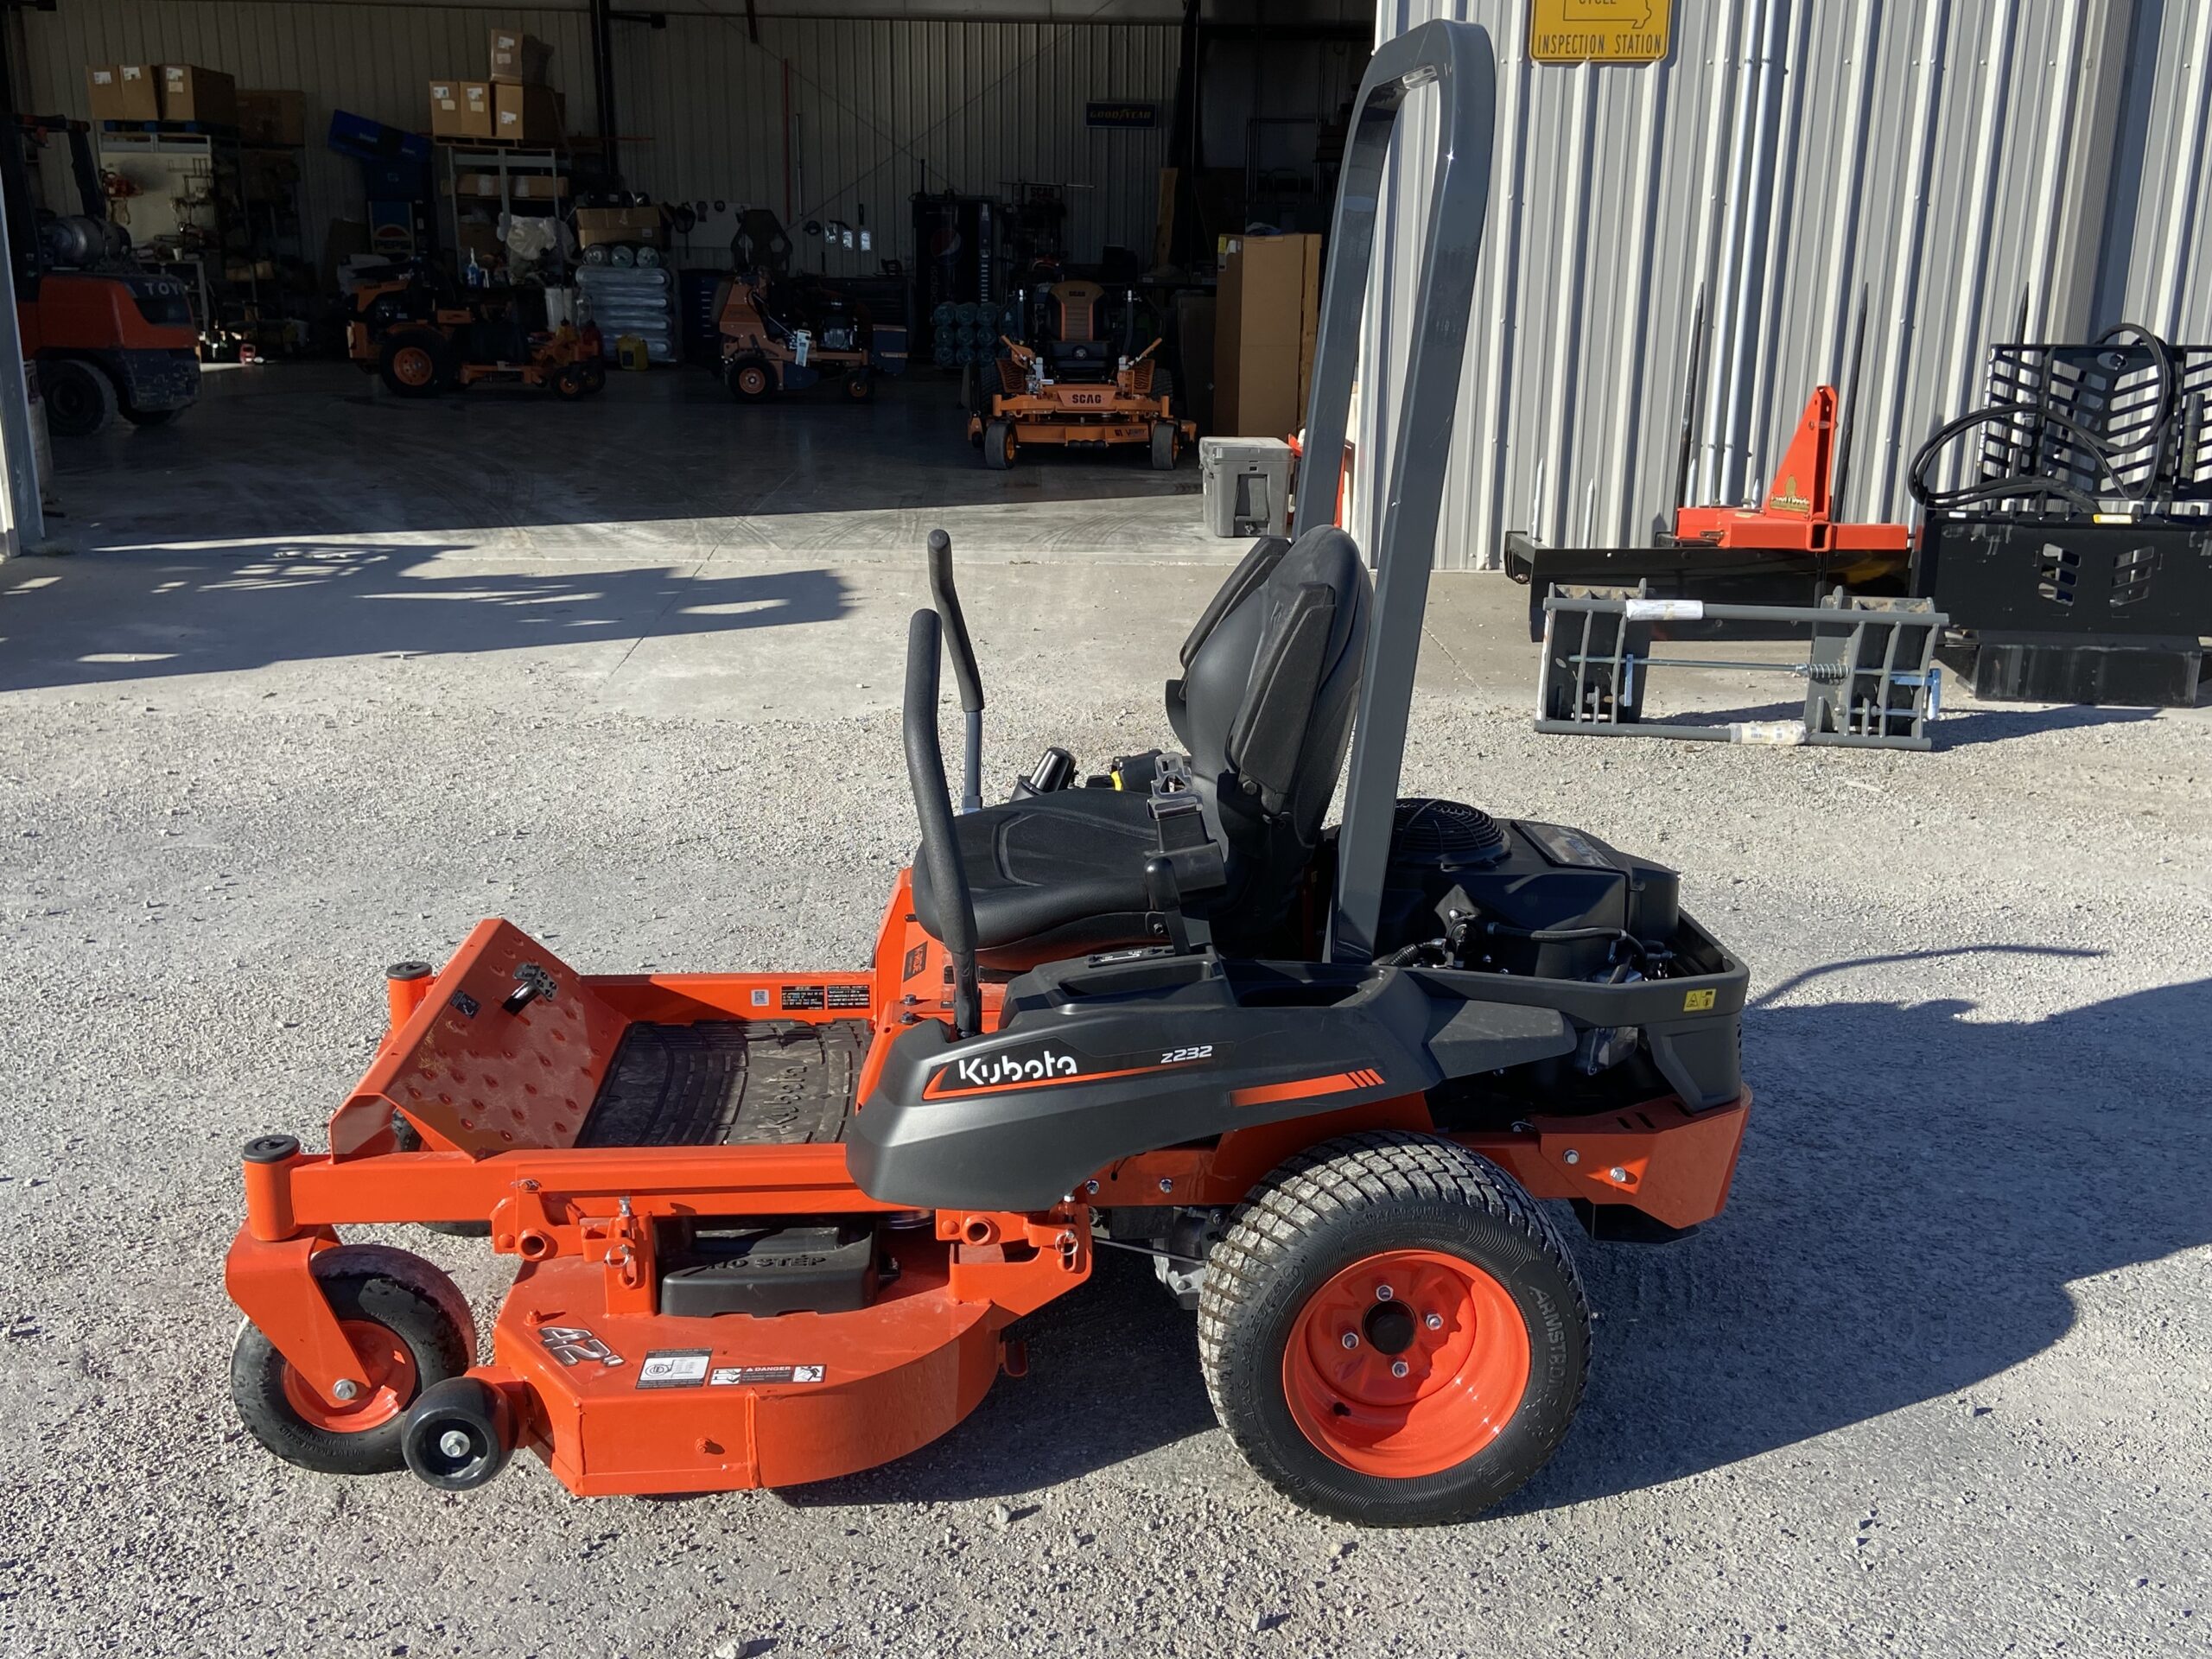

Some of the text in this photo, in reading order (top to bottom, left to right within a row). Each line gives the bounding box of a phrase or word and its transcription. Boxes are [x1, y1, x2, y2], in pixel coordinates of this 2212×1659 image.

[1538, 34, 1662, 54] INSPECTION STATION
[1090, 110, 1152, 120] GOODYEAR
[1072, 394, 1102, 404] SCAG
[958, 1050, 1078, 1085] Kubota
[754, 1256, 826, 1269] STEP
